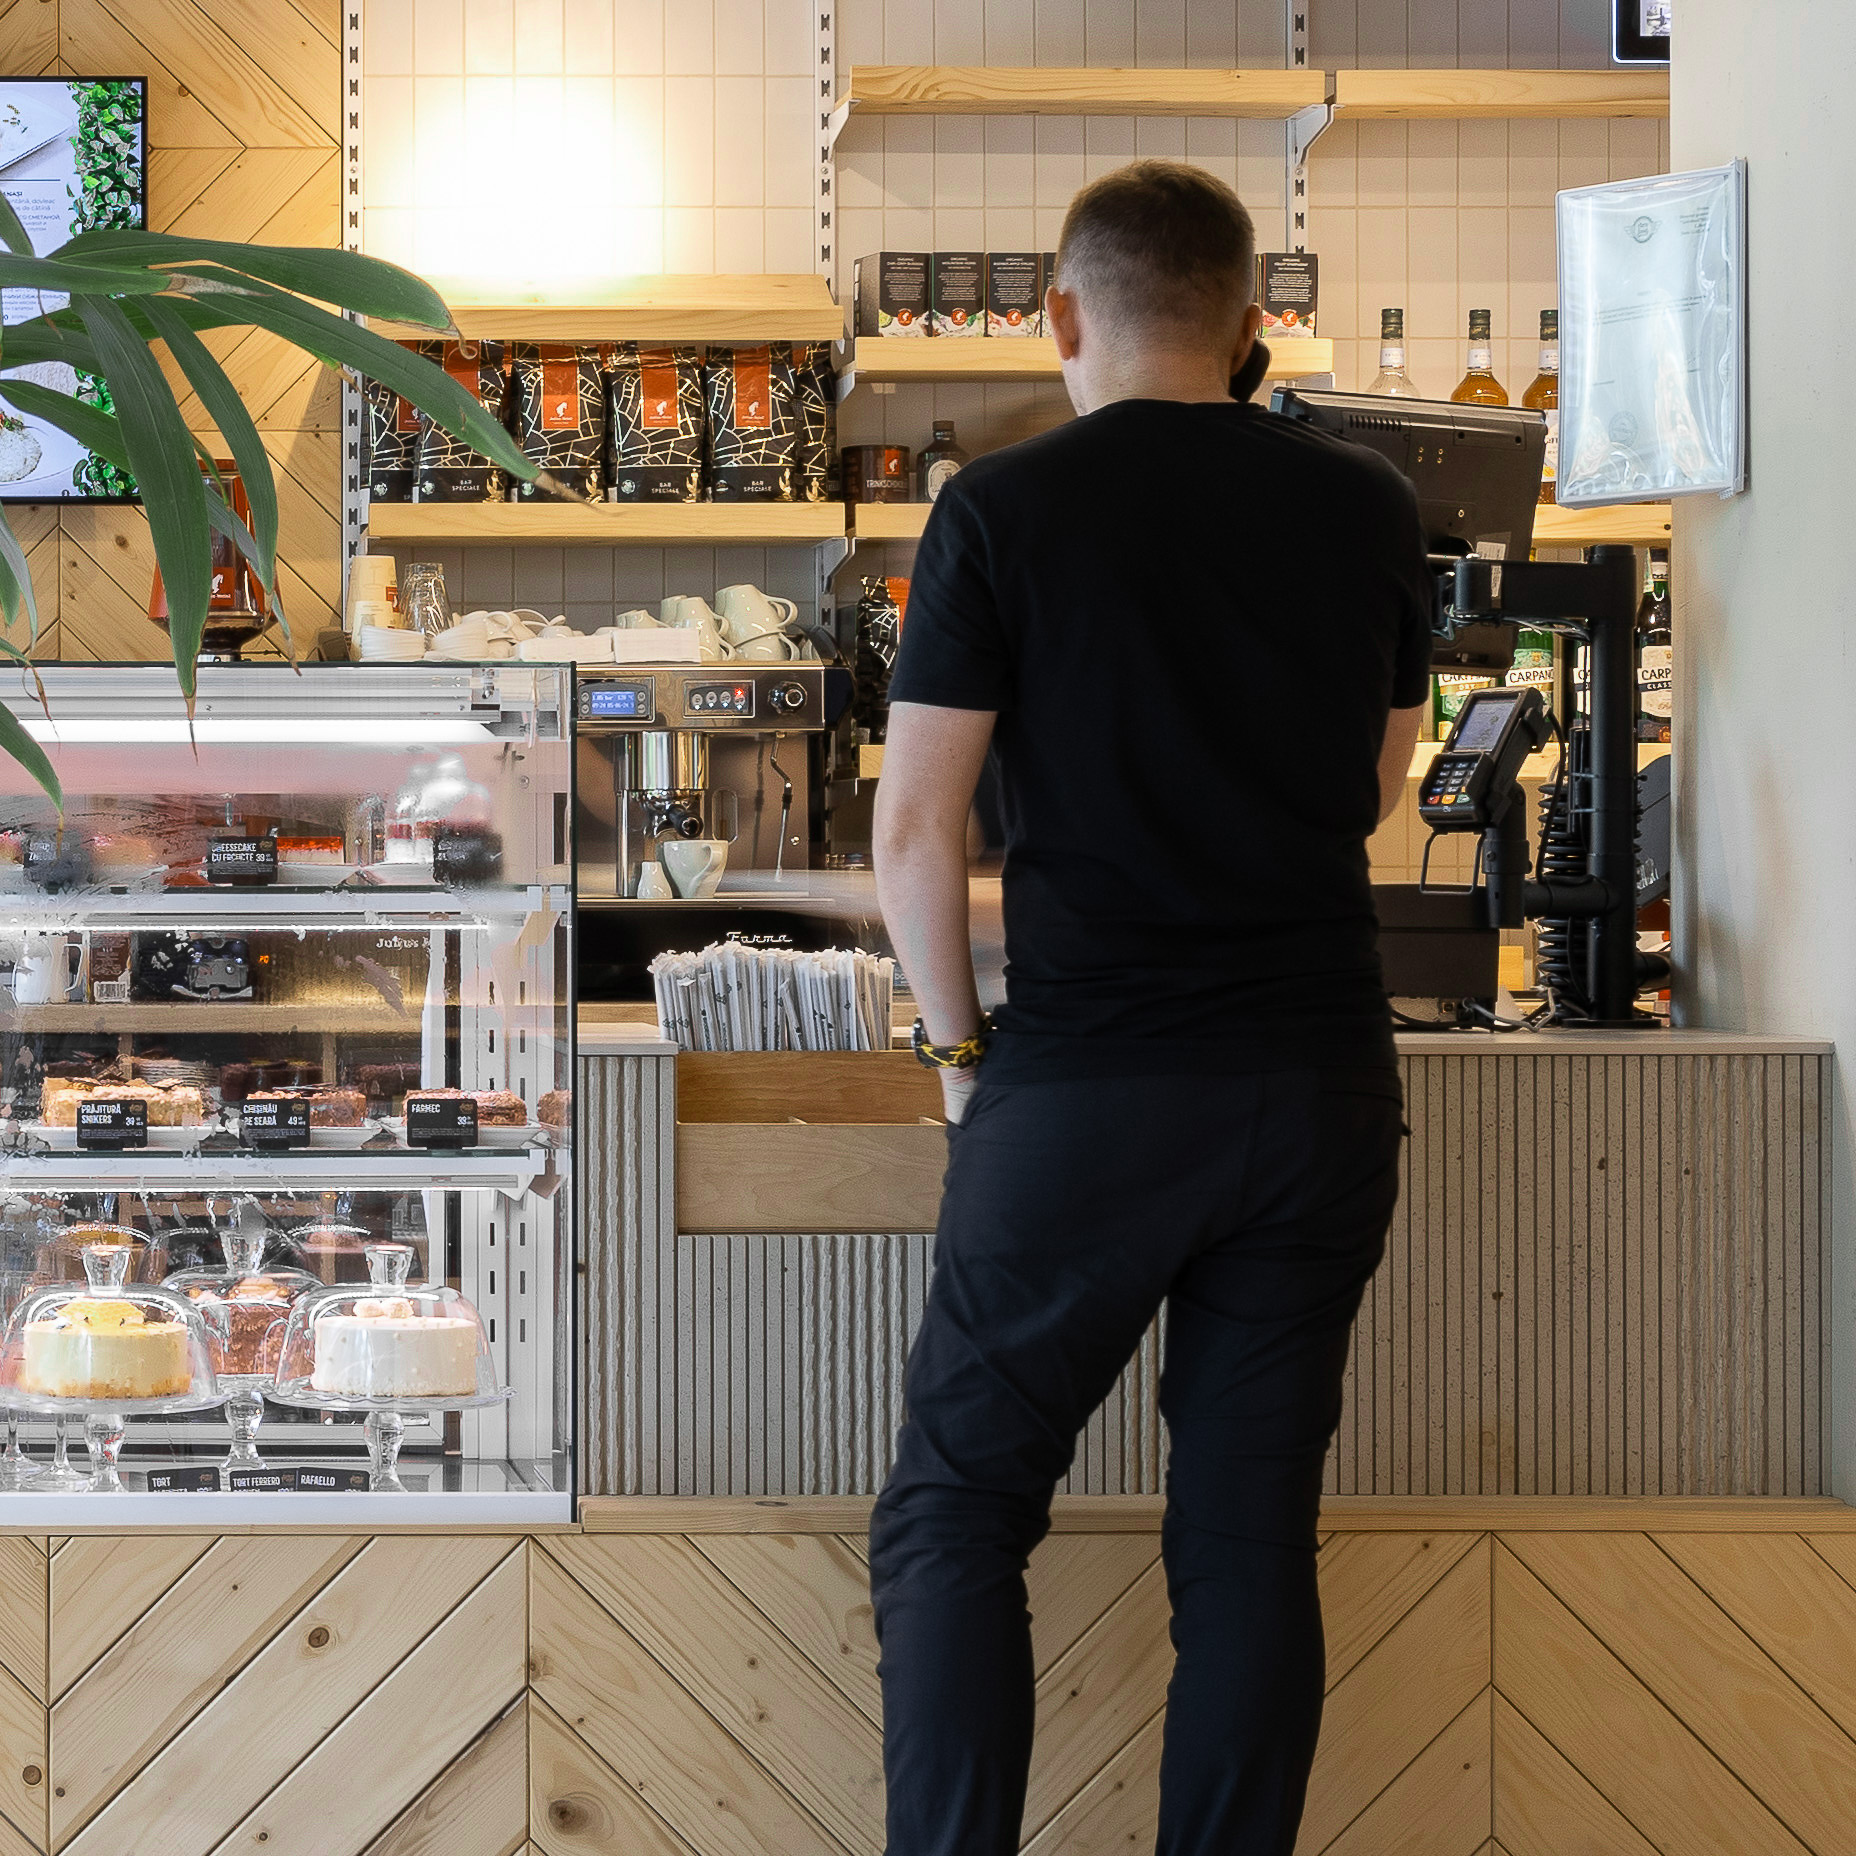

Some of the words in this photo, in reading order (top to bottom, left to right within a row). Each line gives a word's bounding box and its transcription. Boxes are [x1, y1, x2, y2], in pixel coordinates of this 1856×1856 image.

[411, 1103, 441, 1113] FARMEC
[151, 1476, 171, 1488] TORT
[233, 1477, 250, 1487] TORT
[251, 1476, 281, 1486] FERRERO
[300, 1474, 336, 1486] RAFAELLO
